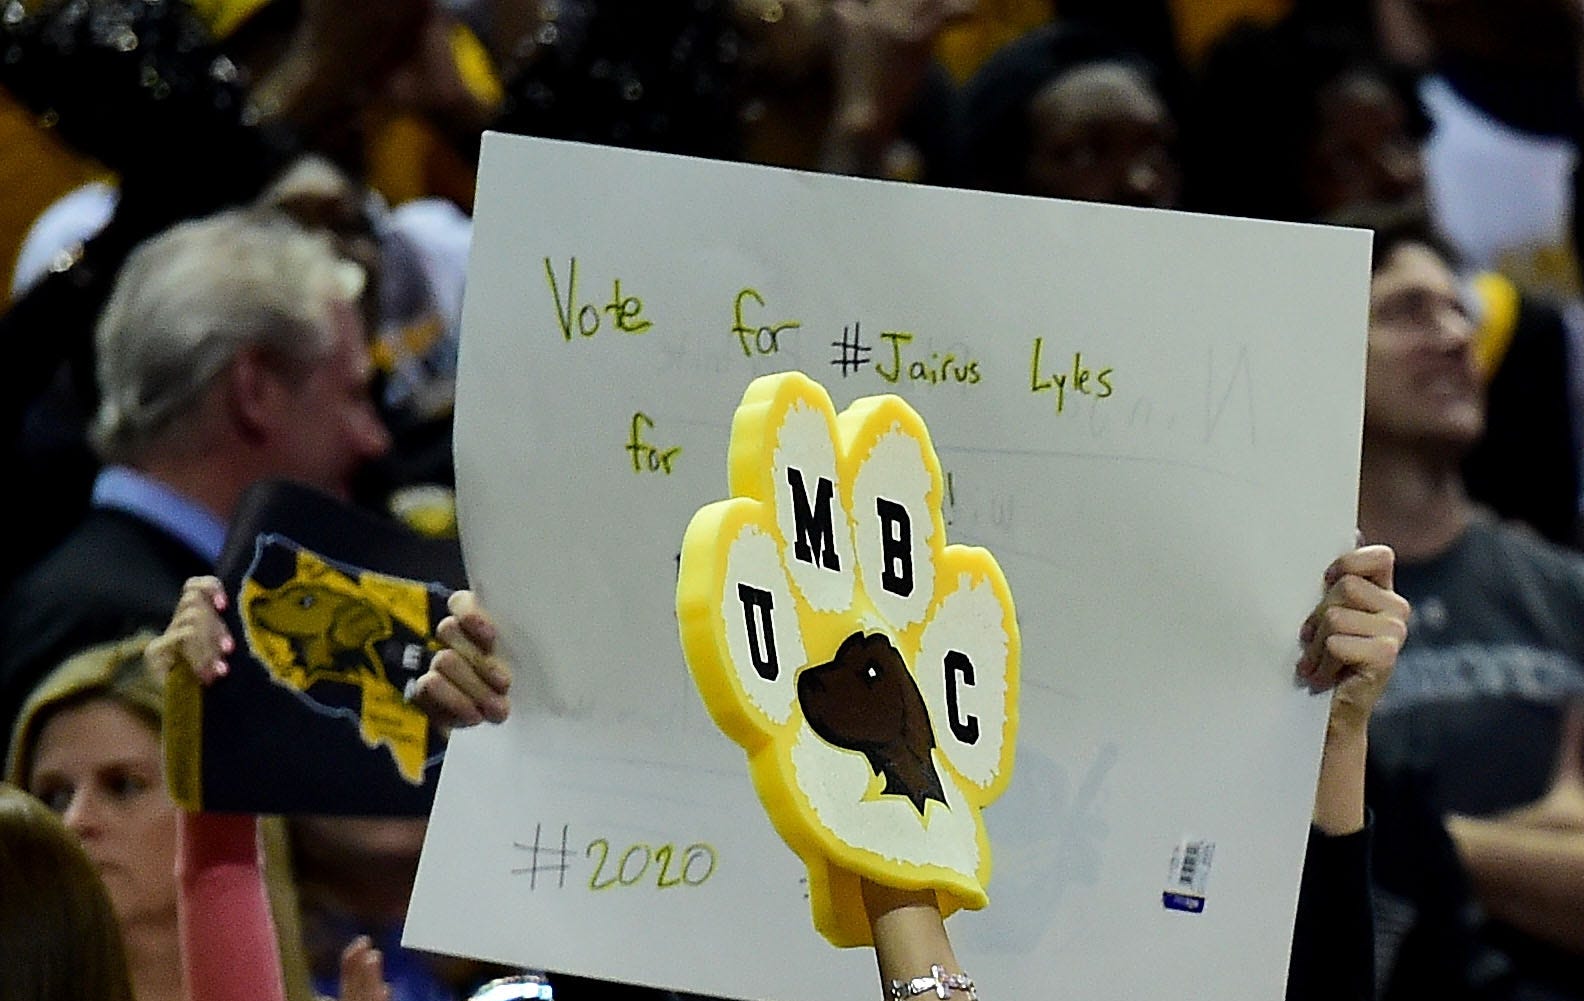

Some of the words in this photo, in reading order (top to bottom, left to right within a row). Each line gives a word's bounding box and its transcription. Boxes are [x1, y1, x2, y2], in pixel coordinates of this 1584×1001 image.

[545, 256, 653, 343] Vote
[731, 286, 801, 357] for
[831, 321, 981, 384] #Jairus
[1029, 336, 1113, 417] Lyles
[625, 410, 683, 476] for
[511, 821, 722, 892] #2020
